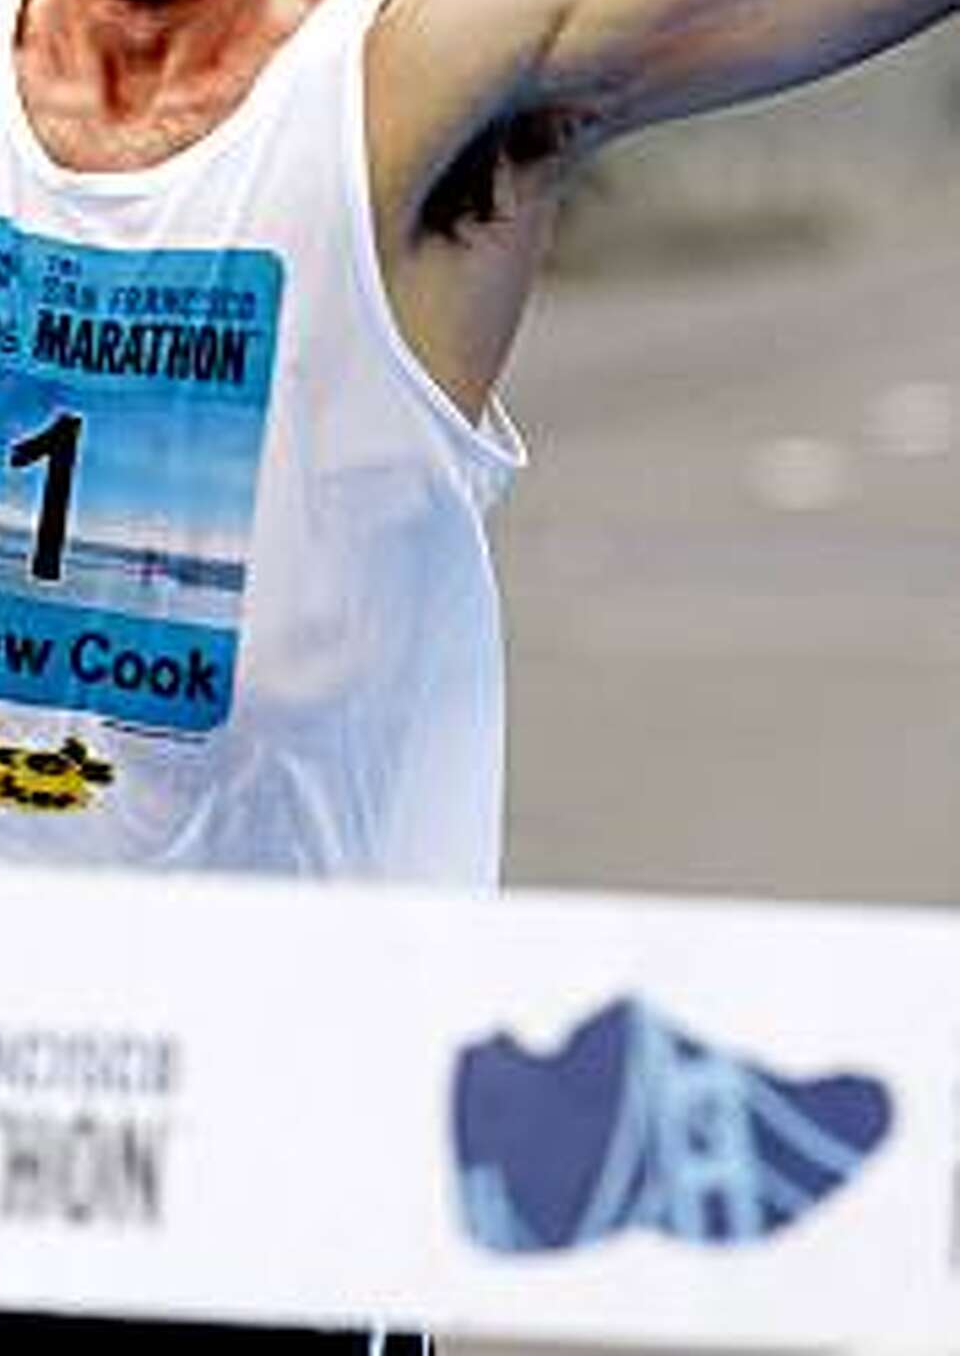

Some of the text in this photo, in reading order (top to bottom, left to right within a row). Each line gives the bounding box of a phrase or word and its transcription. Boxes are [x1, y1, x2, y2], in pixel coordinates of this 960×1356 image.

[41, 275, 257, 322] SAN FRANCISCO
[32, 307, 248, 383] MARATHON
[10, 413, 83, 581] 1
[70, 631, 218, 704] Cook
